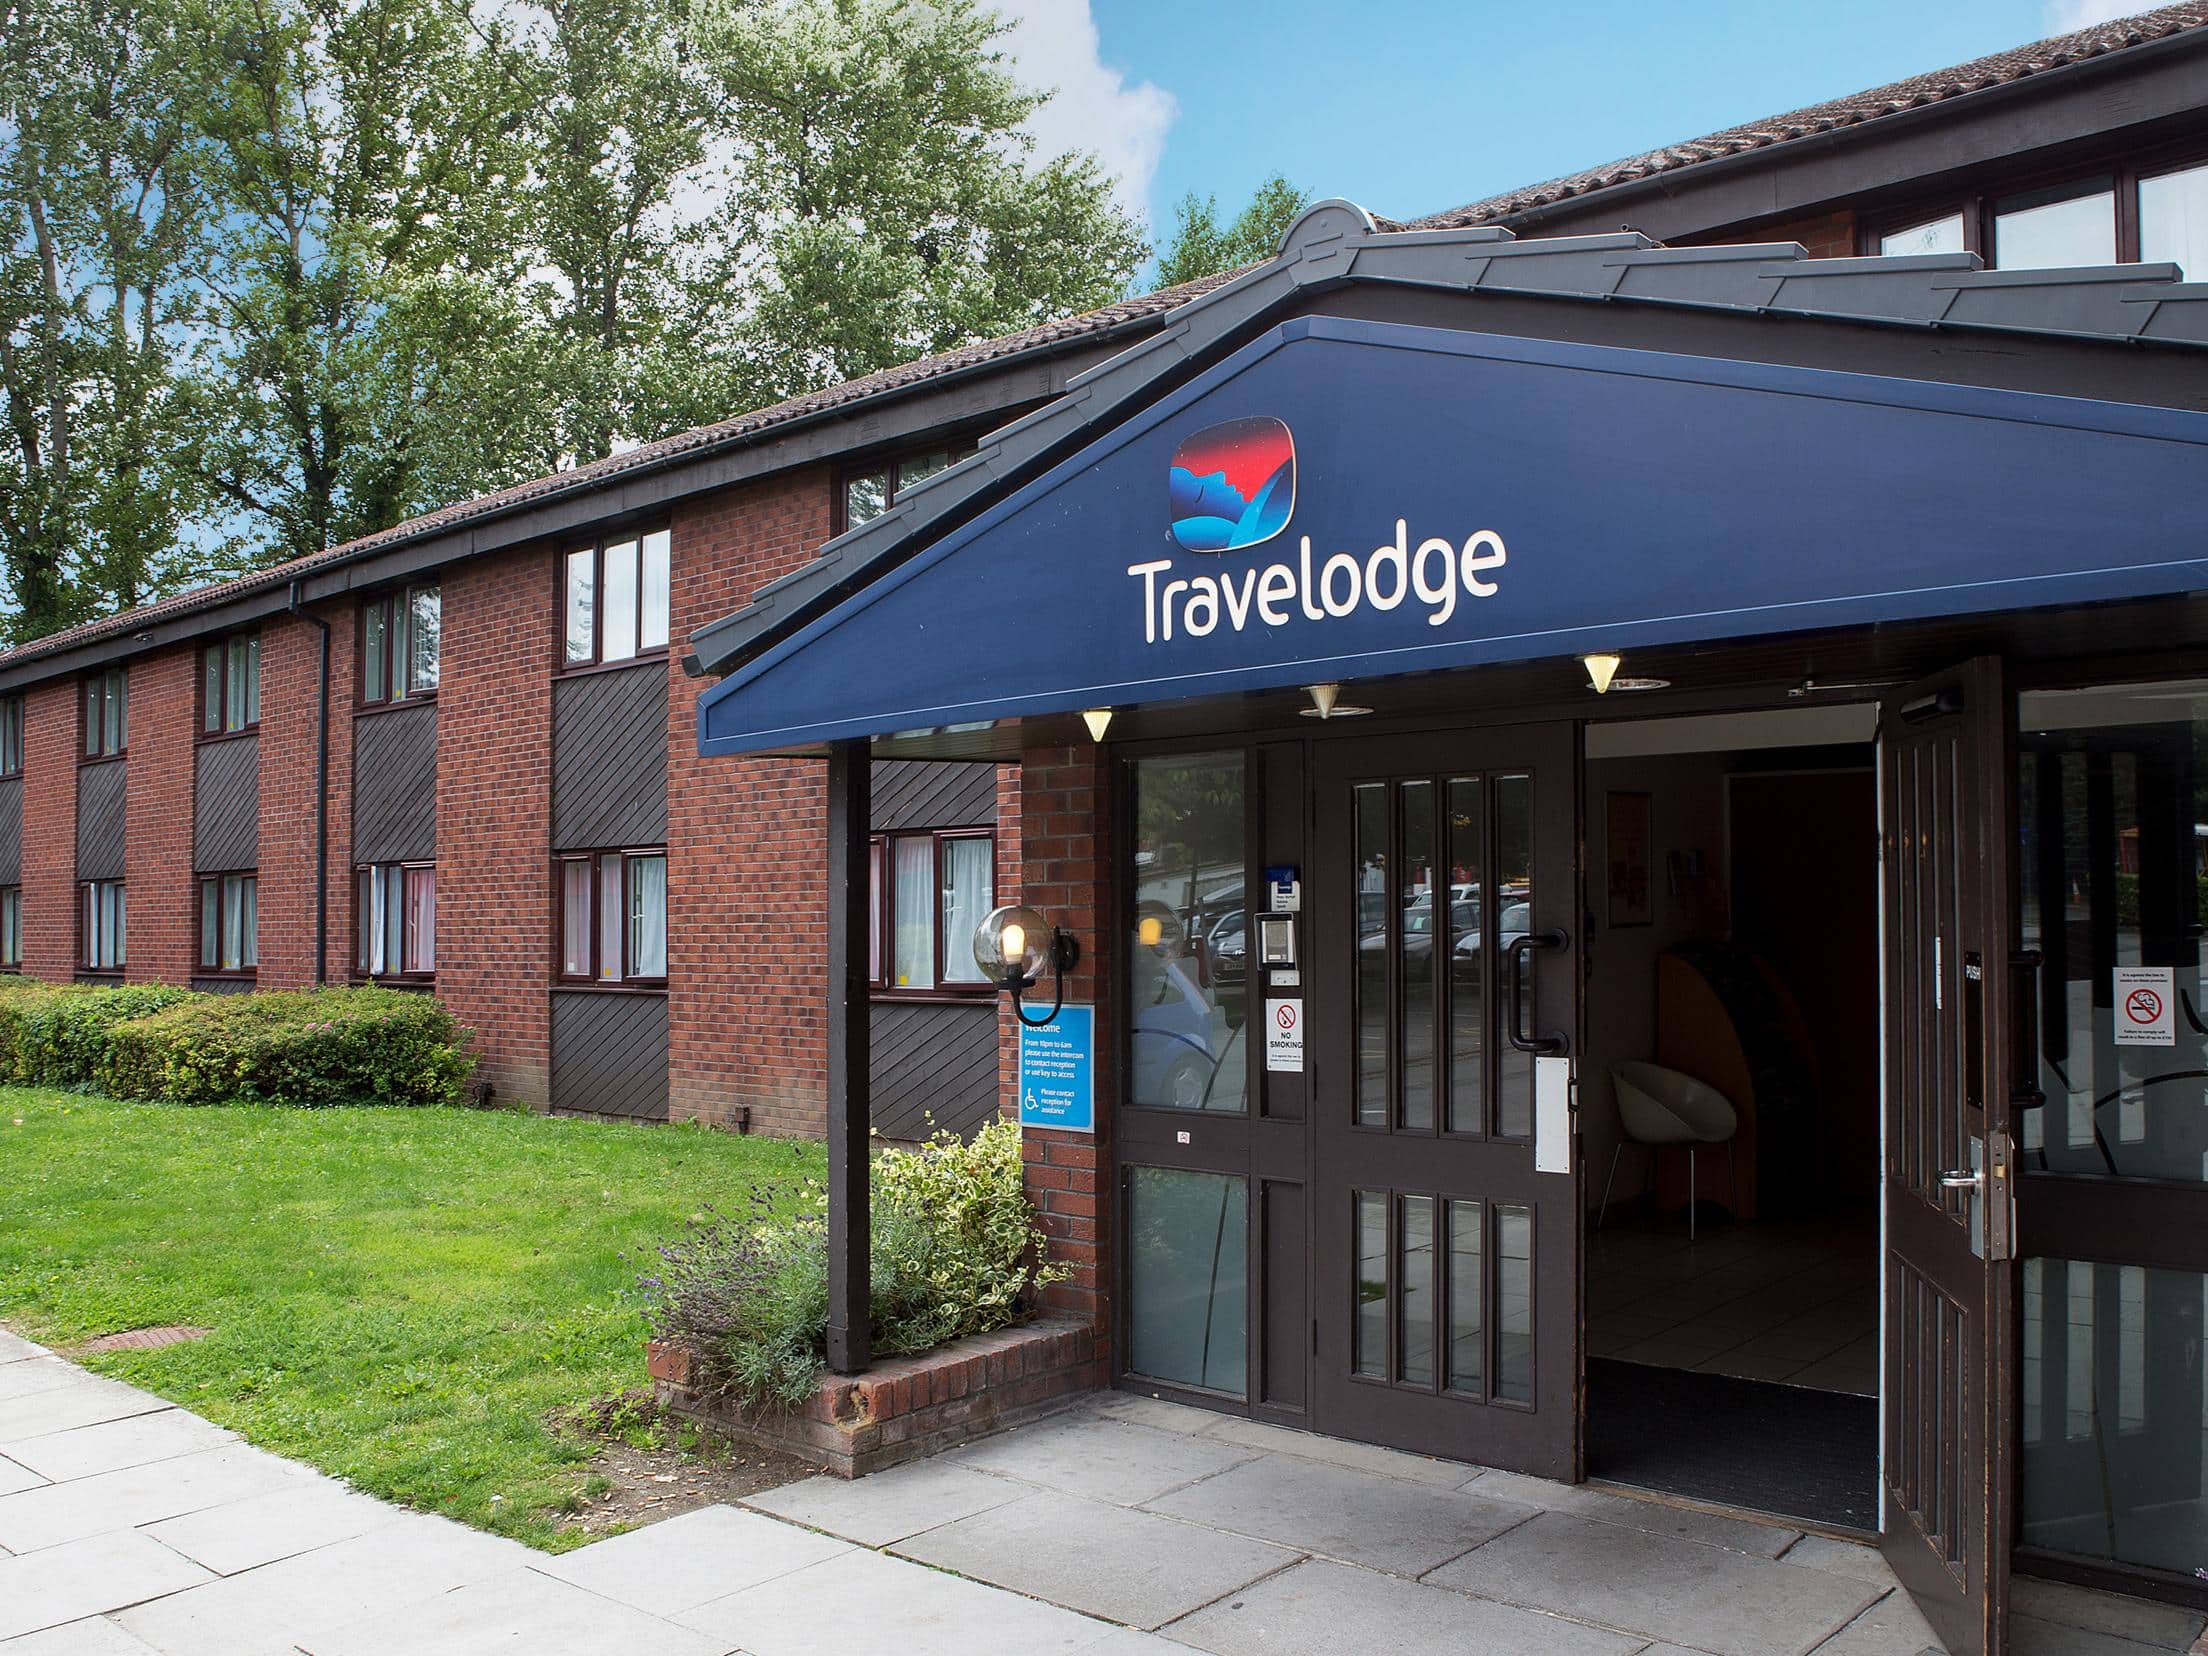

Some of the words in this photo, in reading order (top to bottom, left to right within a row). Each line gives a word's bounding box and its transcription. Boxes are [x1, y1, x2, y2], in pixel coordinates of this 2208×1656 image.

[1127, 518, 1508, 644] Travelodge
[1966, 965, 1981, 980] PUSH
[1281, 1032, 1292, 1040] NO
[1025, 1039, 1039, 1047] From
[1270, 1041, 1303, 1049] SMOKING
[1025, 1049, 1040, 1057] please
[1051, 1050, 1060, 1058] the
[1051, 1061, 1076, 1069] reception
